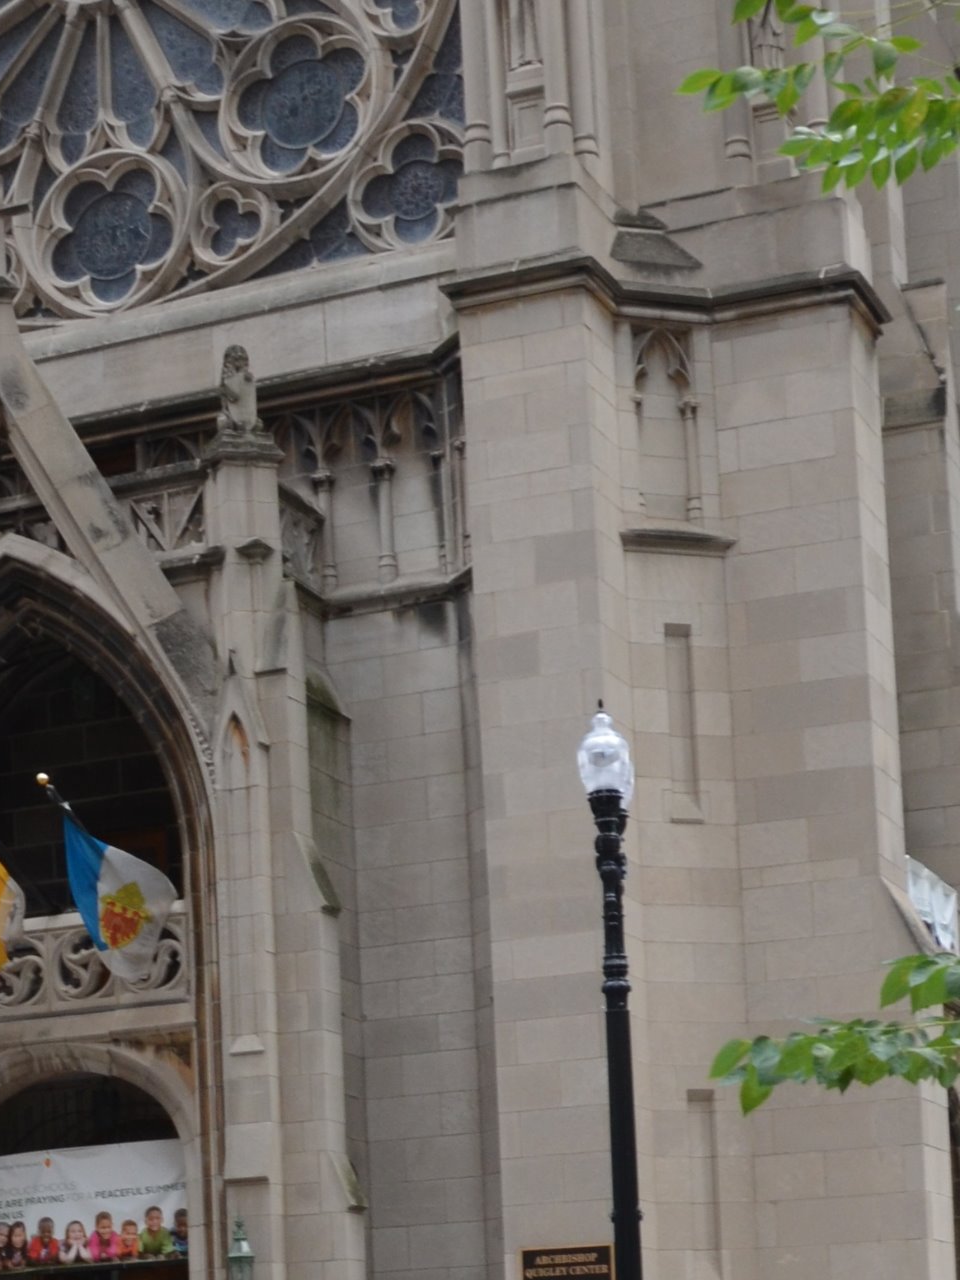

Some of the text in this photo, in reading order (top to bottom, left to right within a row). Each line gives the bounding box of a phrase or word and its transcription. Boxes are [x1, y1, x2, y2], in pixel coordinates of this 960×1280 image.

[5, 1198, 23, 1208] ARE
[25, 1194, 64, 1205] PRAYING
[94, 1187, 145, 1199] PEACEFUL
[535, 1252, 598, 1265] ARCHBISHOP
[525, 1264, 609, 1279] QUIGLEY CENTER
